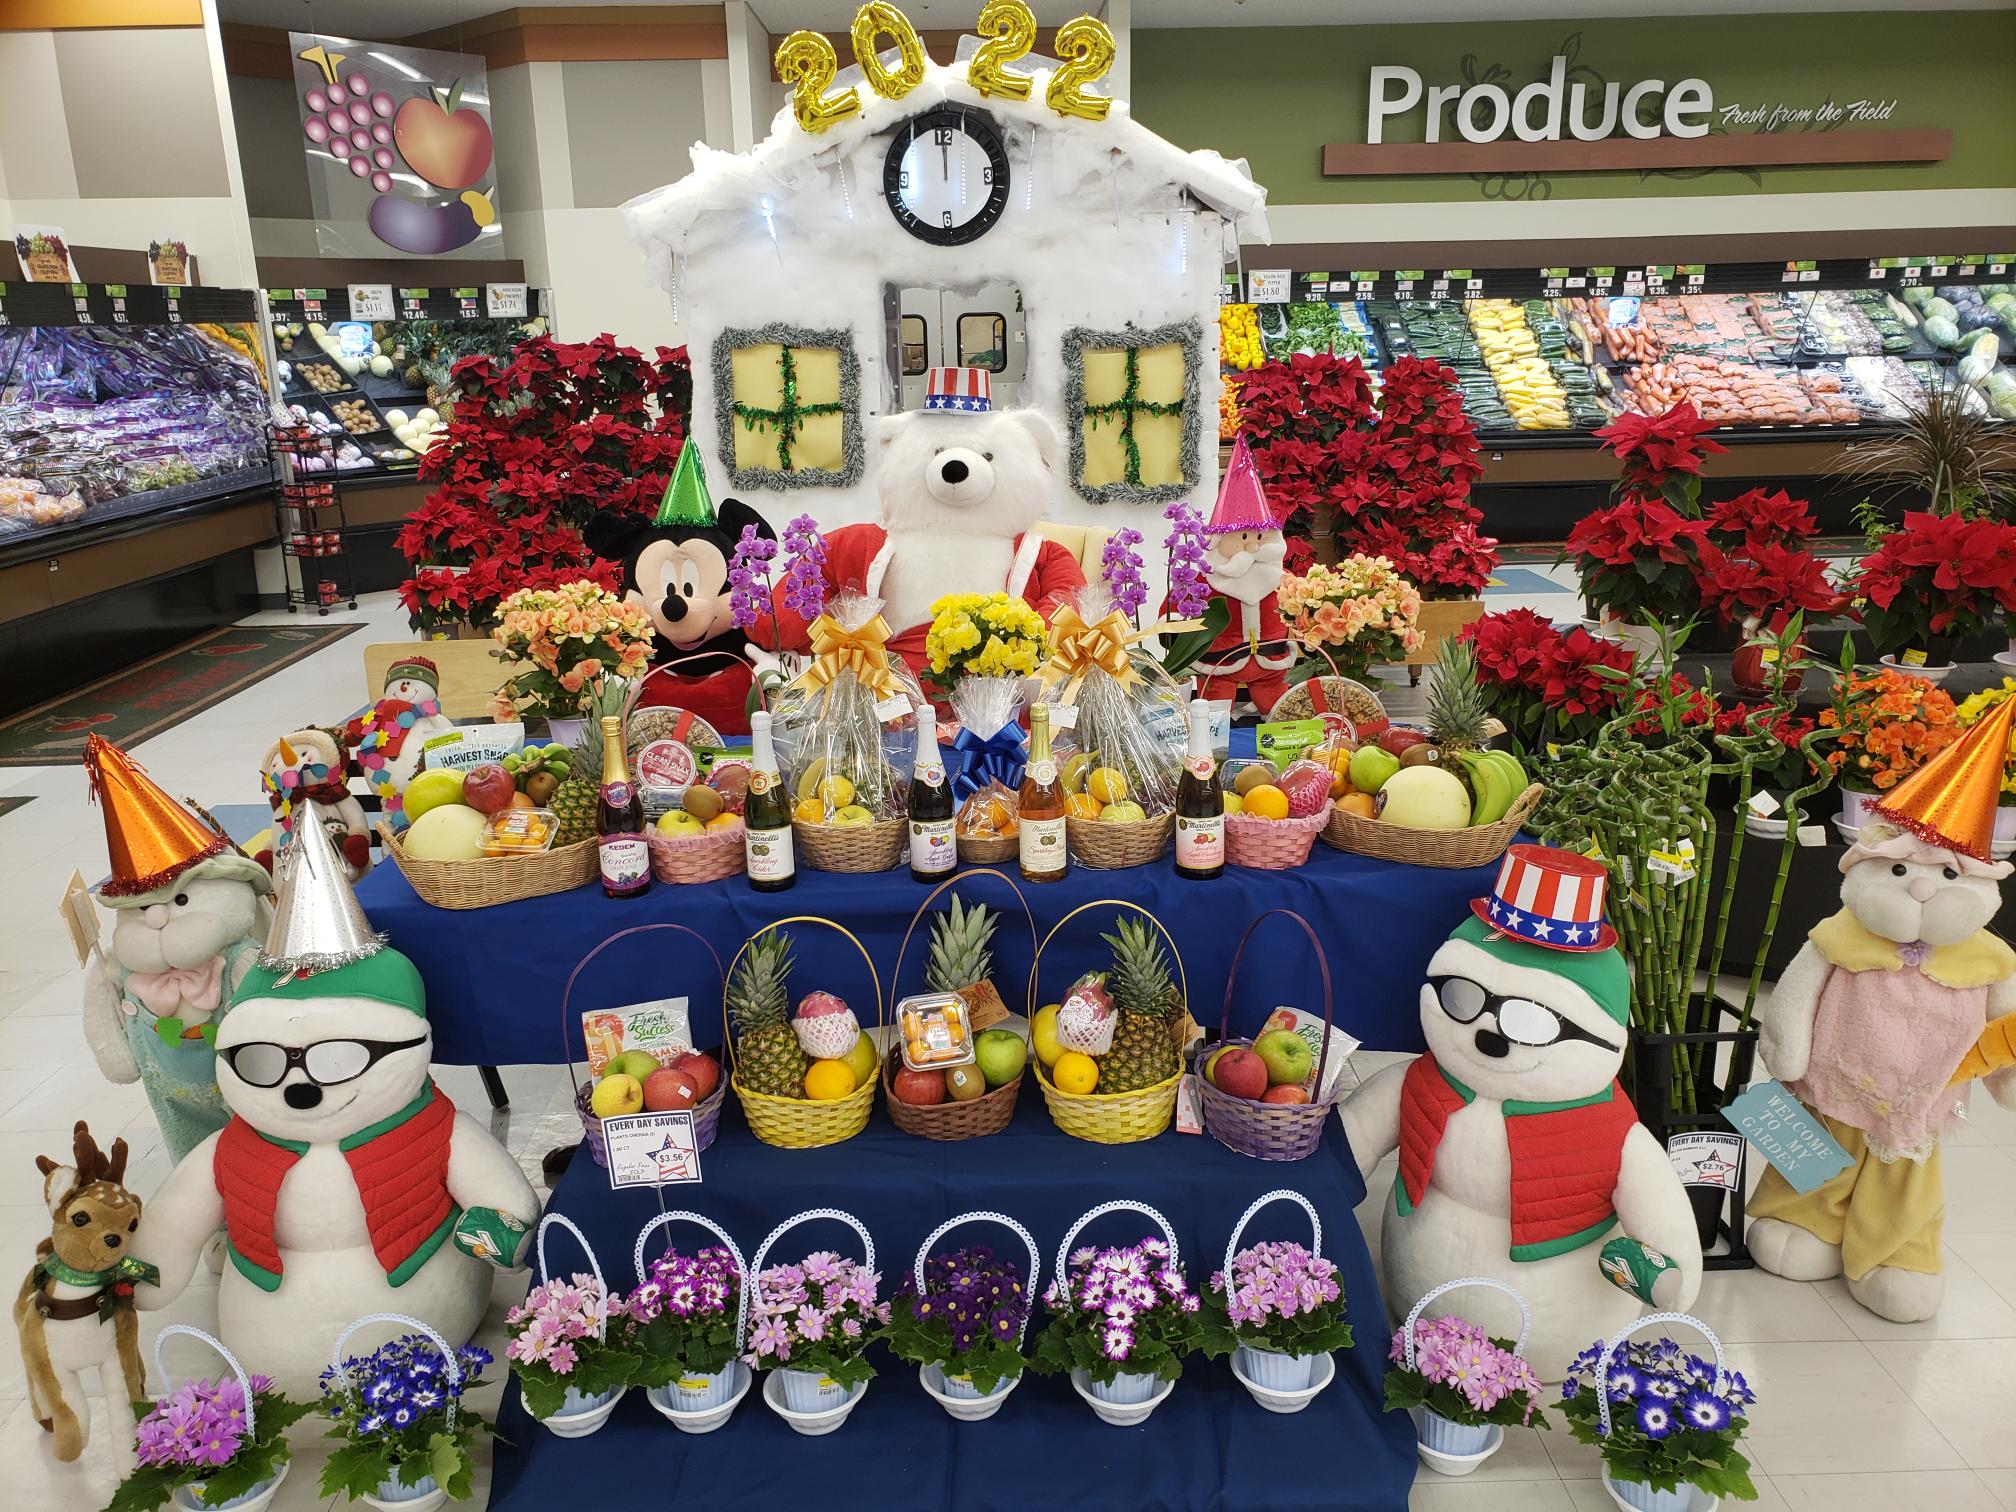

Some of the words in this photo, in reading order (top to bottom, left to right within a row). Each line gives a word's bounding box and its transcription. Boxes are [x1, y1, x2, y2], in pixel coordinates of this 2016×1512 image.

[774, 0, 1116, 135] 2022
[1367, 55, 1714, 144] Produce
[1719, 103, 1767, 125] Fresh
[1766, 102, 1813, 131] from
[1815, 100, 1844, 122] the
[1846, 99, 1898, 122] Field
[936, 129, 952, 144] 12
[900, 172, 909, 187] 9
[984, 168, 993, 183] 3
[943, 212, 952, 227] 6
[440, 750, 483, 768] HARVEST
[646, 750, 671, 767] CLEAN
[669, 762, 690, 776] SNAX
[608, 843, 636, 851] KEDEM
[628, 1011, 671, 1031] Fresh
[633, 1024, 676, 1041] Success
[1295, 1023, 1325, 1044] Fres
[609, 1120, 635, 1132] EVERY
[636, 1118, 652, 1128] DAY
[654, 1116, 689, 1127] SAVINGS
[1767, 1094, 1833, 1160] WELCOME
[1671, 1137, 1690, 1148] EVERY
[1690, 1136, 1705, 1144] DAY
[1706, 1135, 1739, 1146] SAVINGS
[1759, 1110, 1781, 1130] TO
[1786, 1139, 1814, 1160] MY
[1742, 1116, 1801, 1172] GARDEN
[659, 1153, 684, 1164] $3.56
[1702, 1163, 1725, 1171] $2.76
